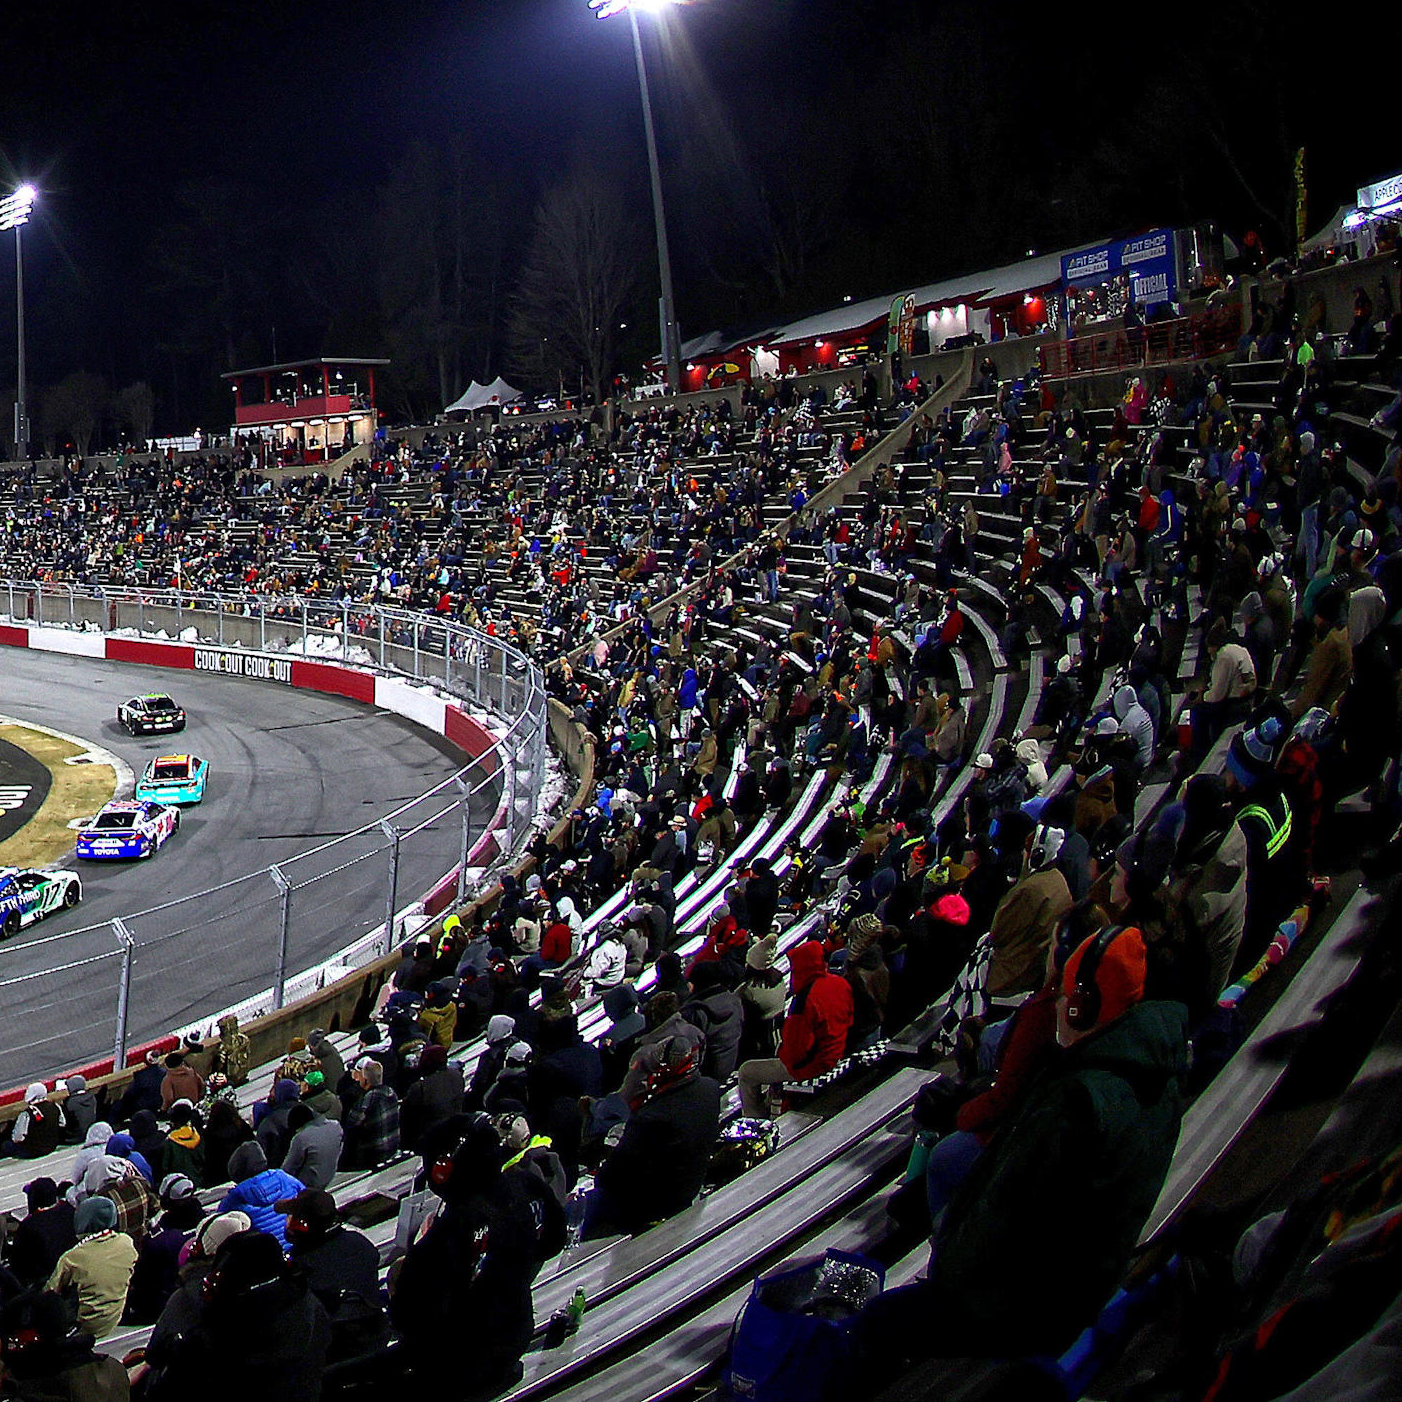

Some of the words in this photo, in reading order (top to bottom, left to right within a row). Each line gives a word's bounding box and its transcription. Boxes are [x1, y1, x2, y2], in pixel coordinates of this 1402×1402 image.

[194, 650, 221, 671] COOK
[225, 654, 243, 674] OUT
[245, 656, 269, 678] COOK
[273, 661, 292, 682] OUT
[18, 889, 42, 906] THIRD
[42, 882, 61, 910] 17
